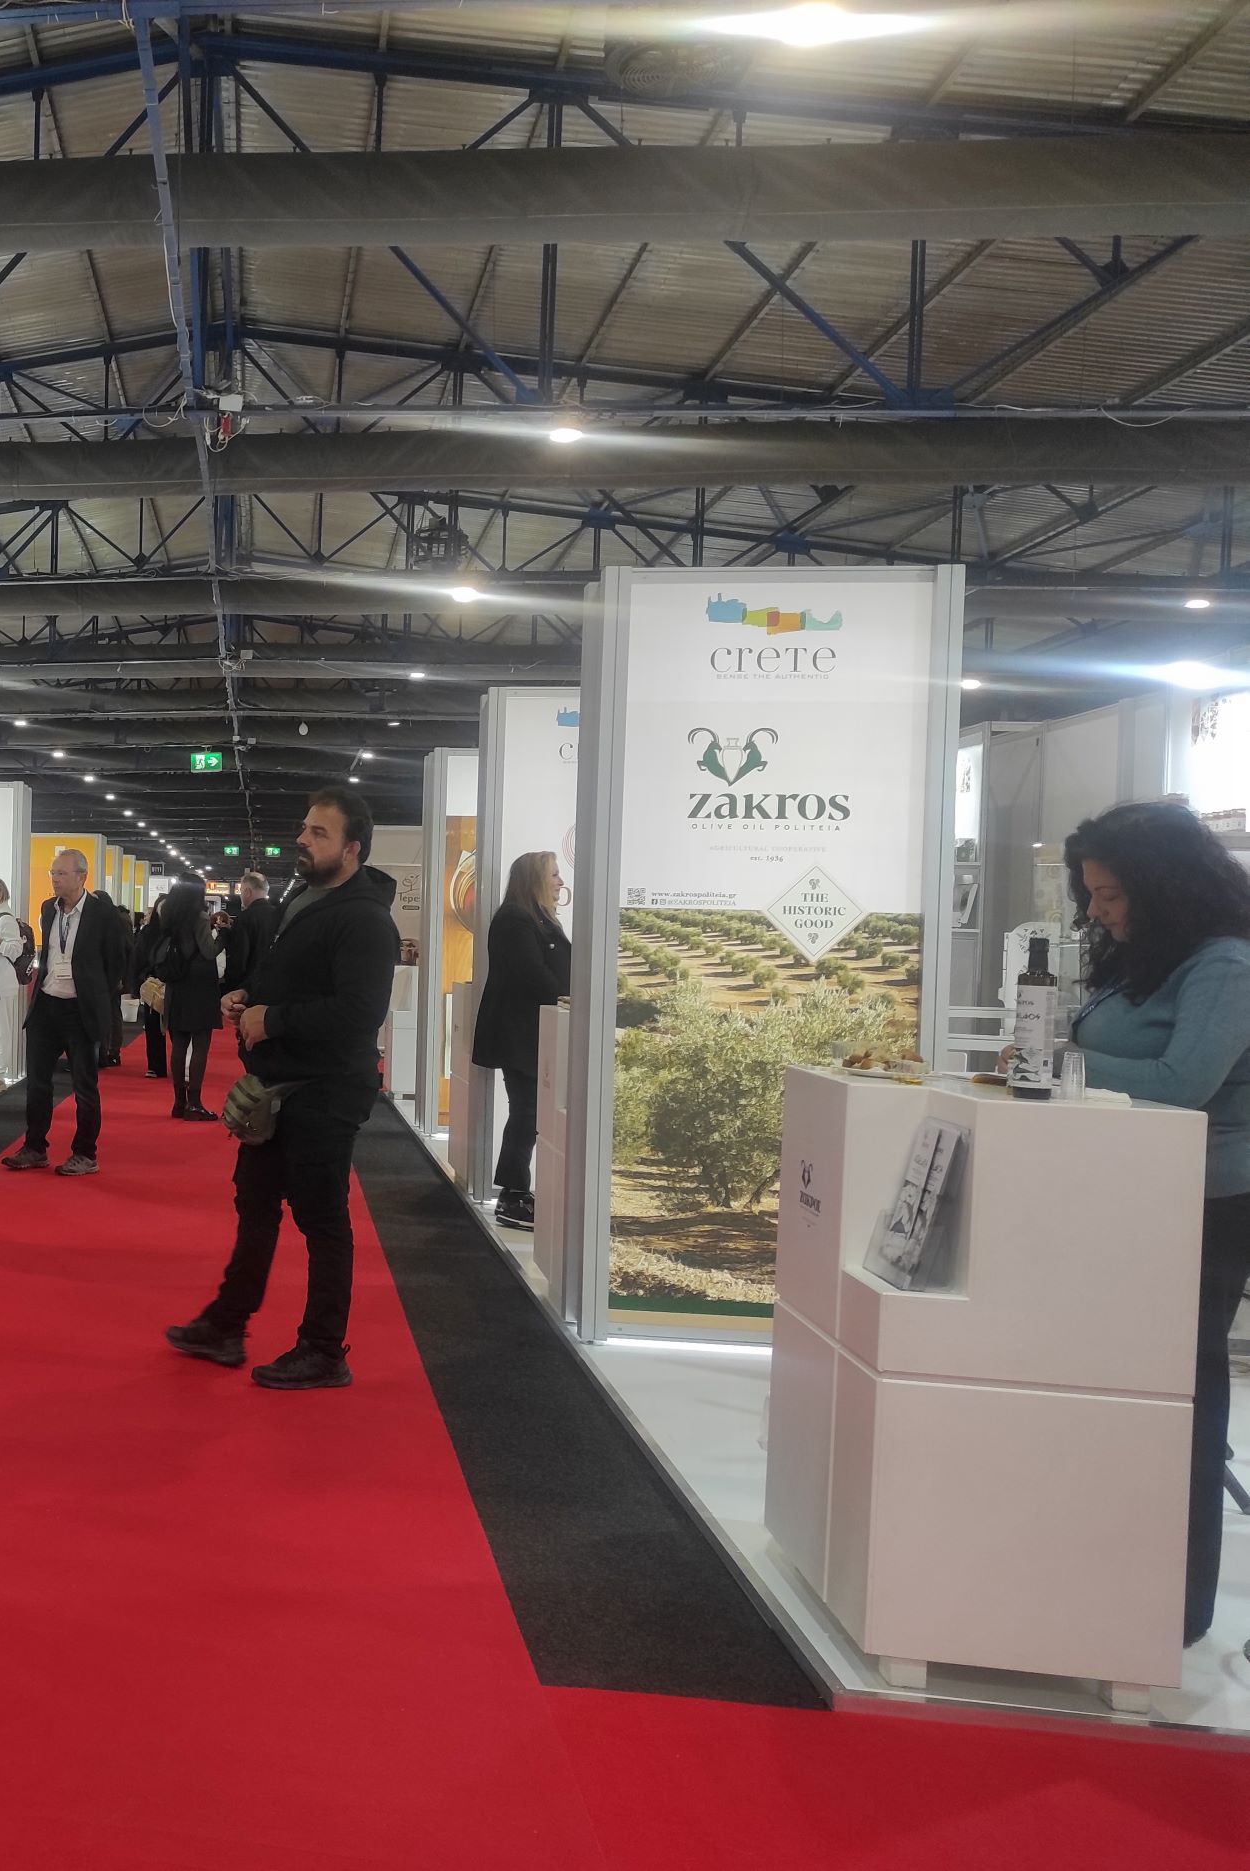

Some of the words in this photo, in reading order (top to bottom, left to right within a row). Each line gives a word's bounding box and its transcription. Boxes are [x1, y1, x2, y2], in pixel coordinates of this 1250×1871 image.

[687, 793, 851, 821] zakros
[801, 893, 829, 903] THE
[782, 906, 846, 916] HISTORIC
[794, 919, 834, 929] GOOD
